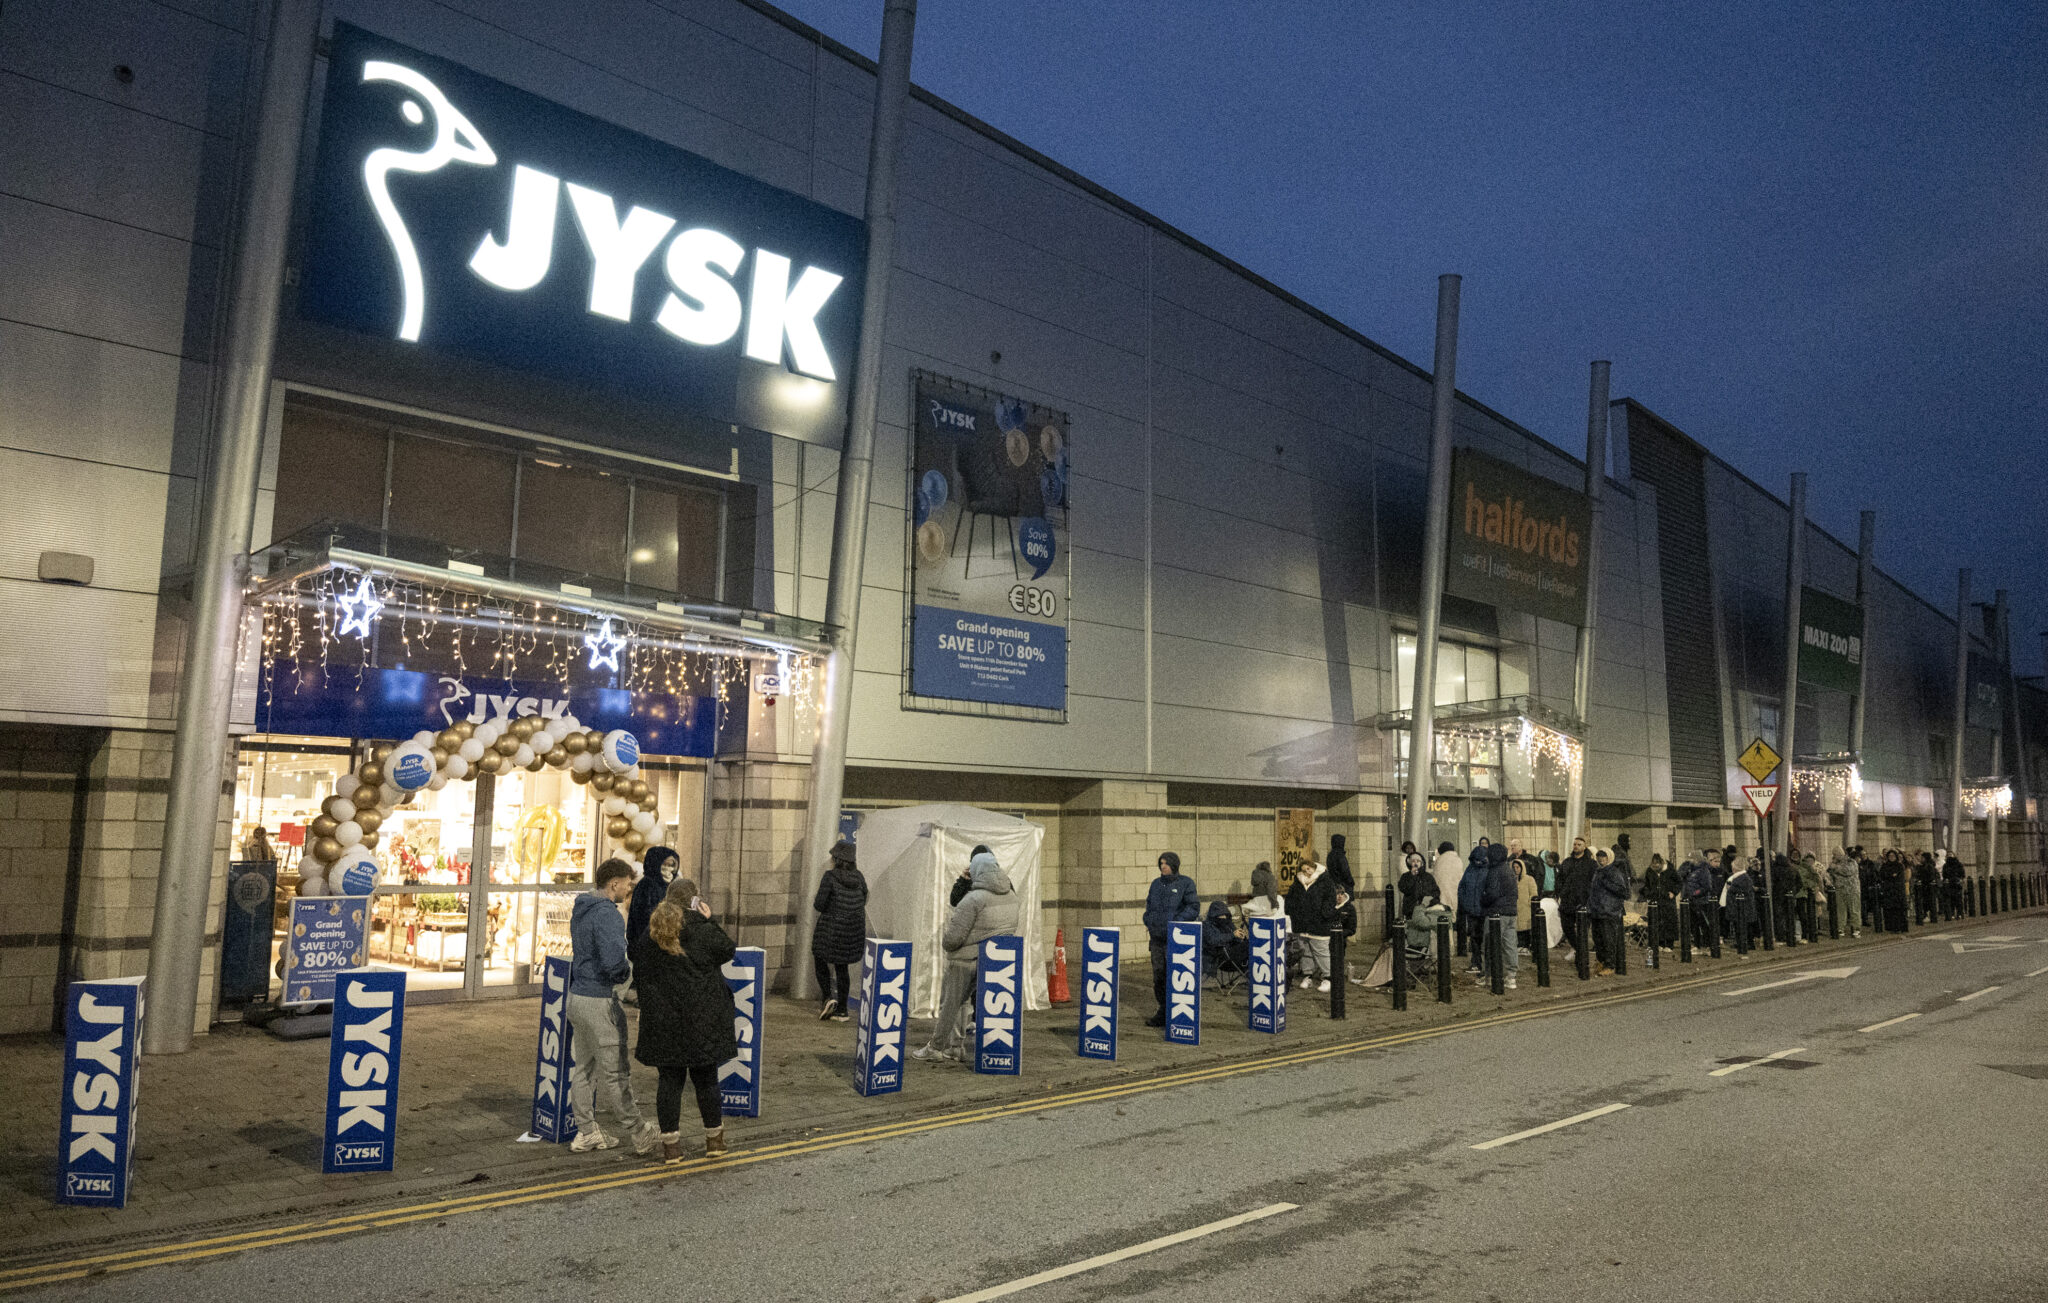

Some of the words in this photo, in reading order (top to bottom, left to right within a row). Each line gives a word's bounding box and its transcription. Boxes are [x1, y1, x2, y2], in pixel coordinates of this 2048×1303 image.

[468, 164, 844, 383] JYSK
[940, 408, 976, 431] JYSK
[1028, 527, 1048, 542] Save
[1464, 481, 1579, 567] halfords
[1026, 541, 1049, 558] 80%
[1008, 584, 1056, 618] €30
[956, 619, 988, 634] Grand
[990, 625, 1030, 643] opening
[1804, 625, 1829, 650] MAXI
[1830, 633, 1848, 656] ZOO
[938, 634, 975, 653] SAVE
[977, 639, 995, 655] UP
[997, 641, 1014, 658] TO
[1016, 645, 1045, 662] 80%
[466, 693, 570, 724] JYSK
[1750, 789, 1773, 798] YIELD
[1281, 850, 1304, 866] 20%
[310, 931, 346, 940] opening
[315, 920, 343, 929] Grand
[300, 942, 326, 951] SAVE
[327, 941, 340, 950] UP
[341, 940, 354, 949] TO
[303, 951, 347, 968] 80%
[1252, 921, 1271, 1011] JYSK
[1085, 933, 1114, 1035] JYSK
[1171, 926, 1196, 1022] JYSK
[856, 944, 874, 1065] JYSK
[982, 940, 1016, 1048] JYSK
[874, 949, 907, 1067] JYSK
[537, 963, 565, 1107] JYSK
[1175, 1028, 1193, 1037] JYSK
[337, 980, 394, 1136] JYSK
[1089, 1042, 1109, 1051] JYSK
[988, 1058, 1011, 1066] JYSK
[68, 992, 125, 1164] JYSK
[877, 1074, 896, 1084] JYSK
[723, 1095, 749, 1104] JYSK
[539, 1114, 553, 1129] JYSK
[345, 1147, 381, 1159] JYSK
[76, 1179, 111, 1192] JYSK
